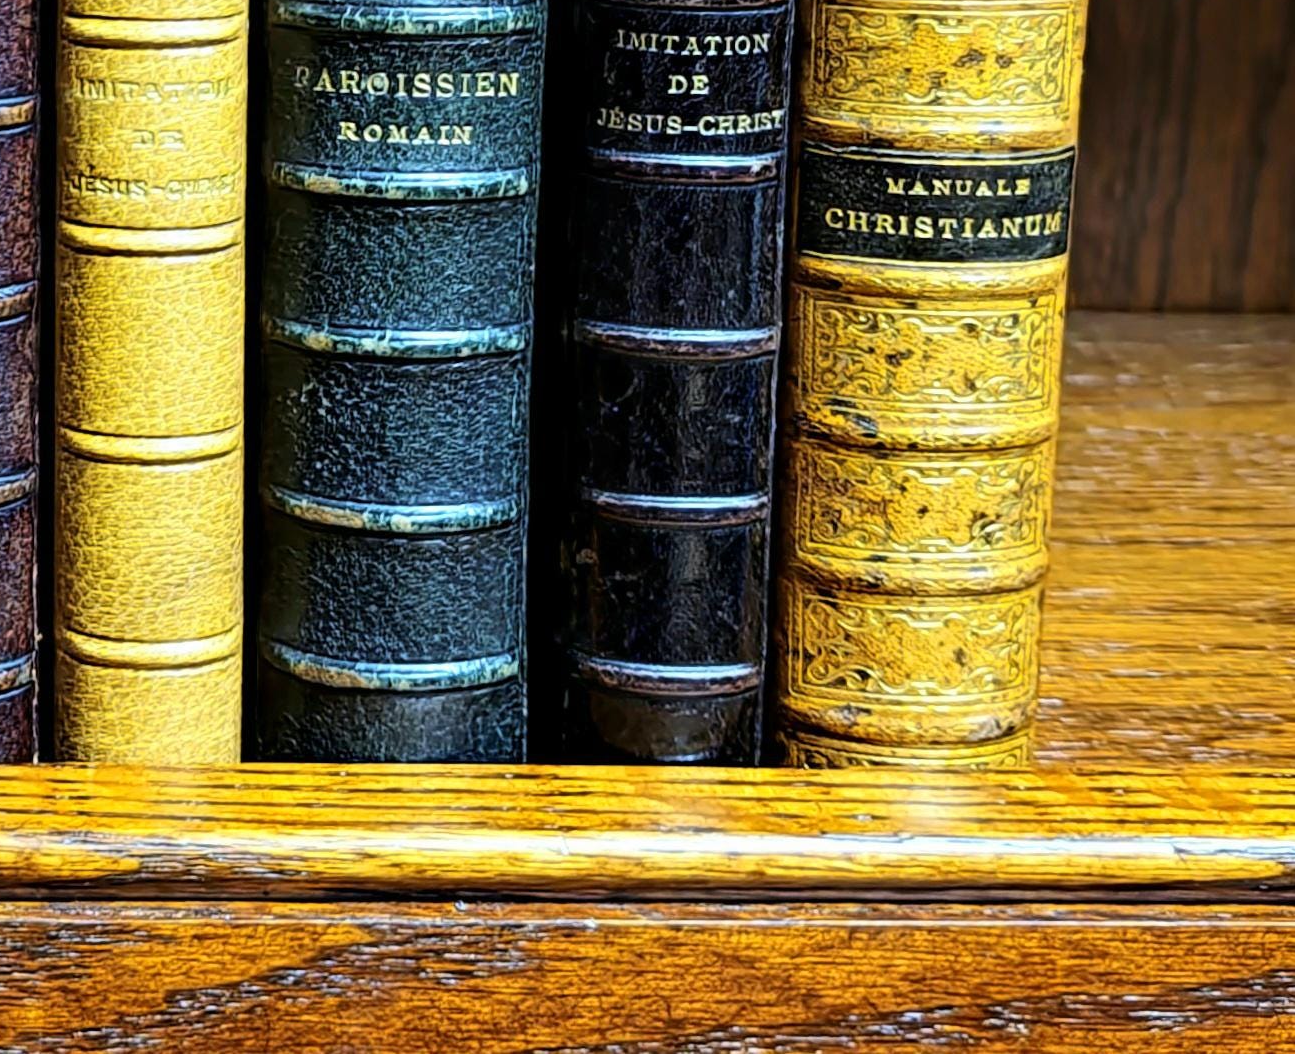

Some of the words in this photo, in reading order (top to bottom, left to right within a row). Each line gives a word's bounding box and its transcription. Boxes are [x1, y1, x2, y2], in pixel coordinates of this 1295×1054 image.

[616, 29, 772, 56] IMITATION
[293, 65, 520, 98] PAROISSIEN
[667, 74, 710, 95] DE
[336, 121, 474, 145] ROMAIN
[596, 106, 786, 136] JÉSUS-CHRIST
[885, 177, 1032, 197] MANUALE
[824, 207, 1063, 239] CHRISTIANUM
